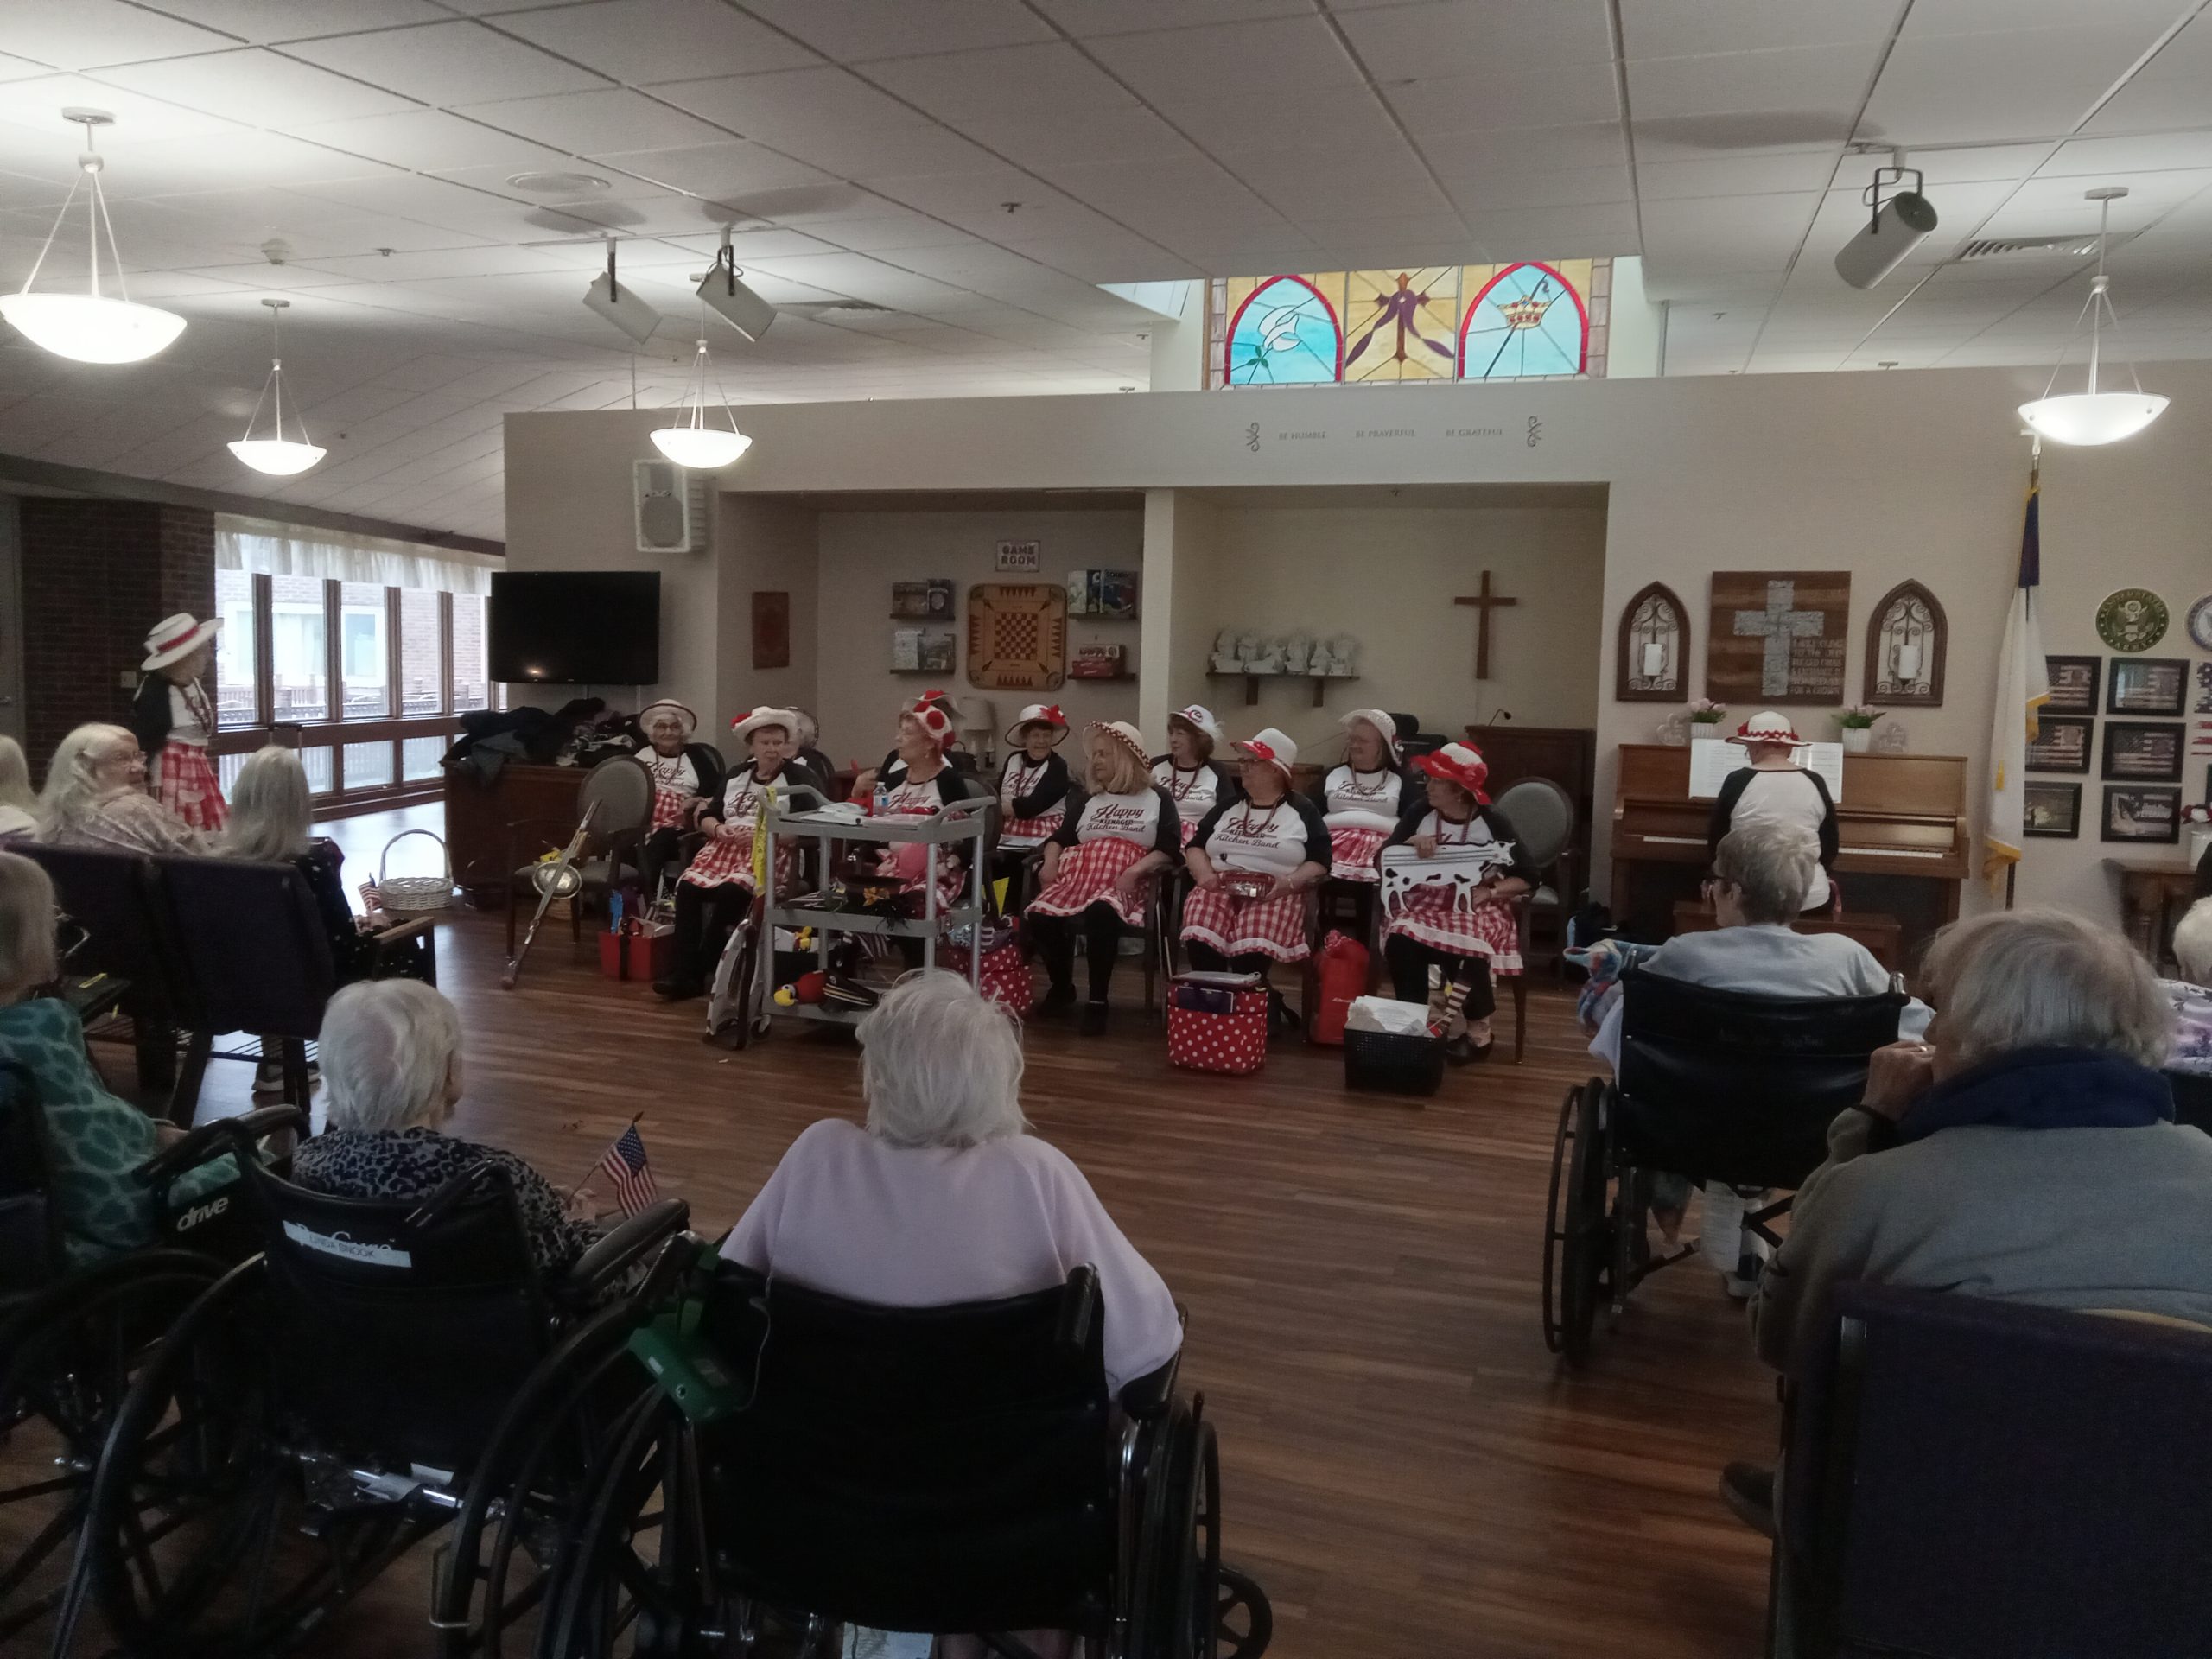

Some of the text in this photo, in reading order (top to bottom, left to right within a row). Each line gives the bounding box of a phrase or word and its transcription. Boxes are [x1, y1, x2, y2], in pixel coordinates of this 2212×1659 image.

[1291, 431, 1326, 440] HUMBLE
[1368, 429, 1416, 438] PRAYERFUL
[1446, 429, 1503, 437] BE GRATEFUL
[1002, 545, 1035, 555] GAME
[1001, 556, 1036, 565] ROOM
[1091, 804, 1145, 819] Happy
[1086, 823, 1118, 831] Kitchen
[1215, 833, 1281, 849] Kitchen Band
[176, 1197, 229, 1232] drive
